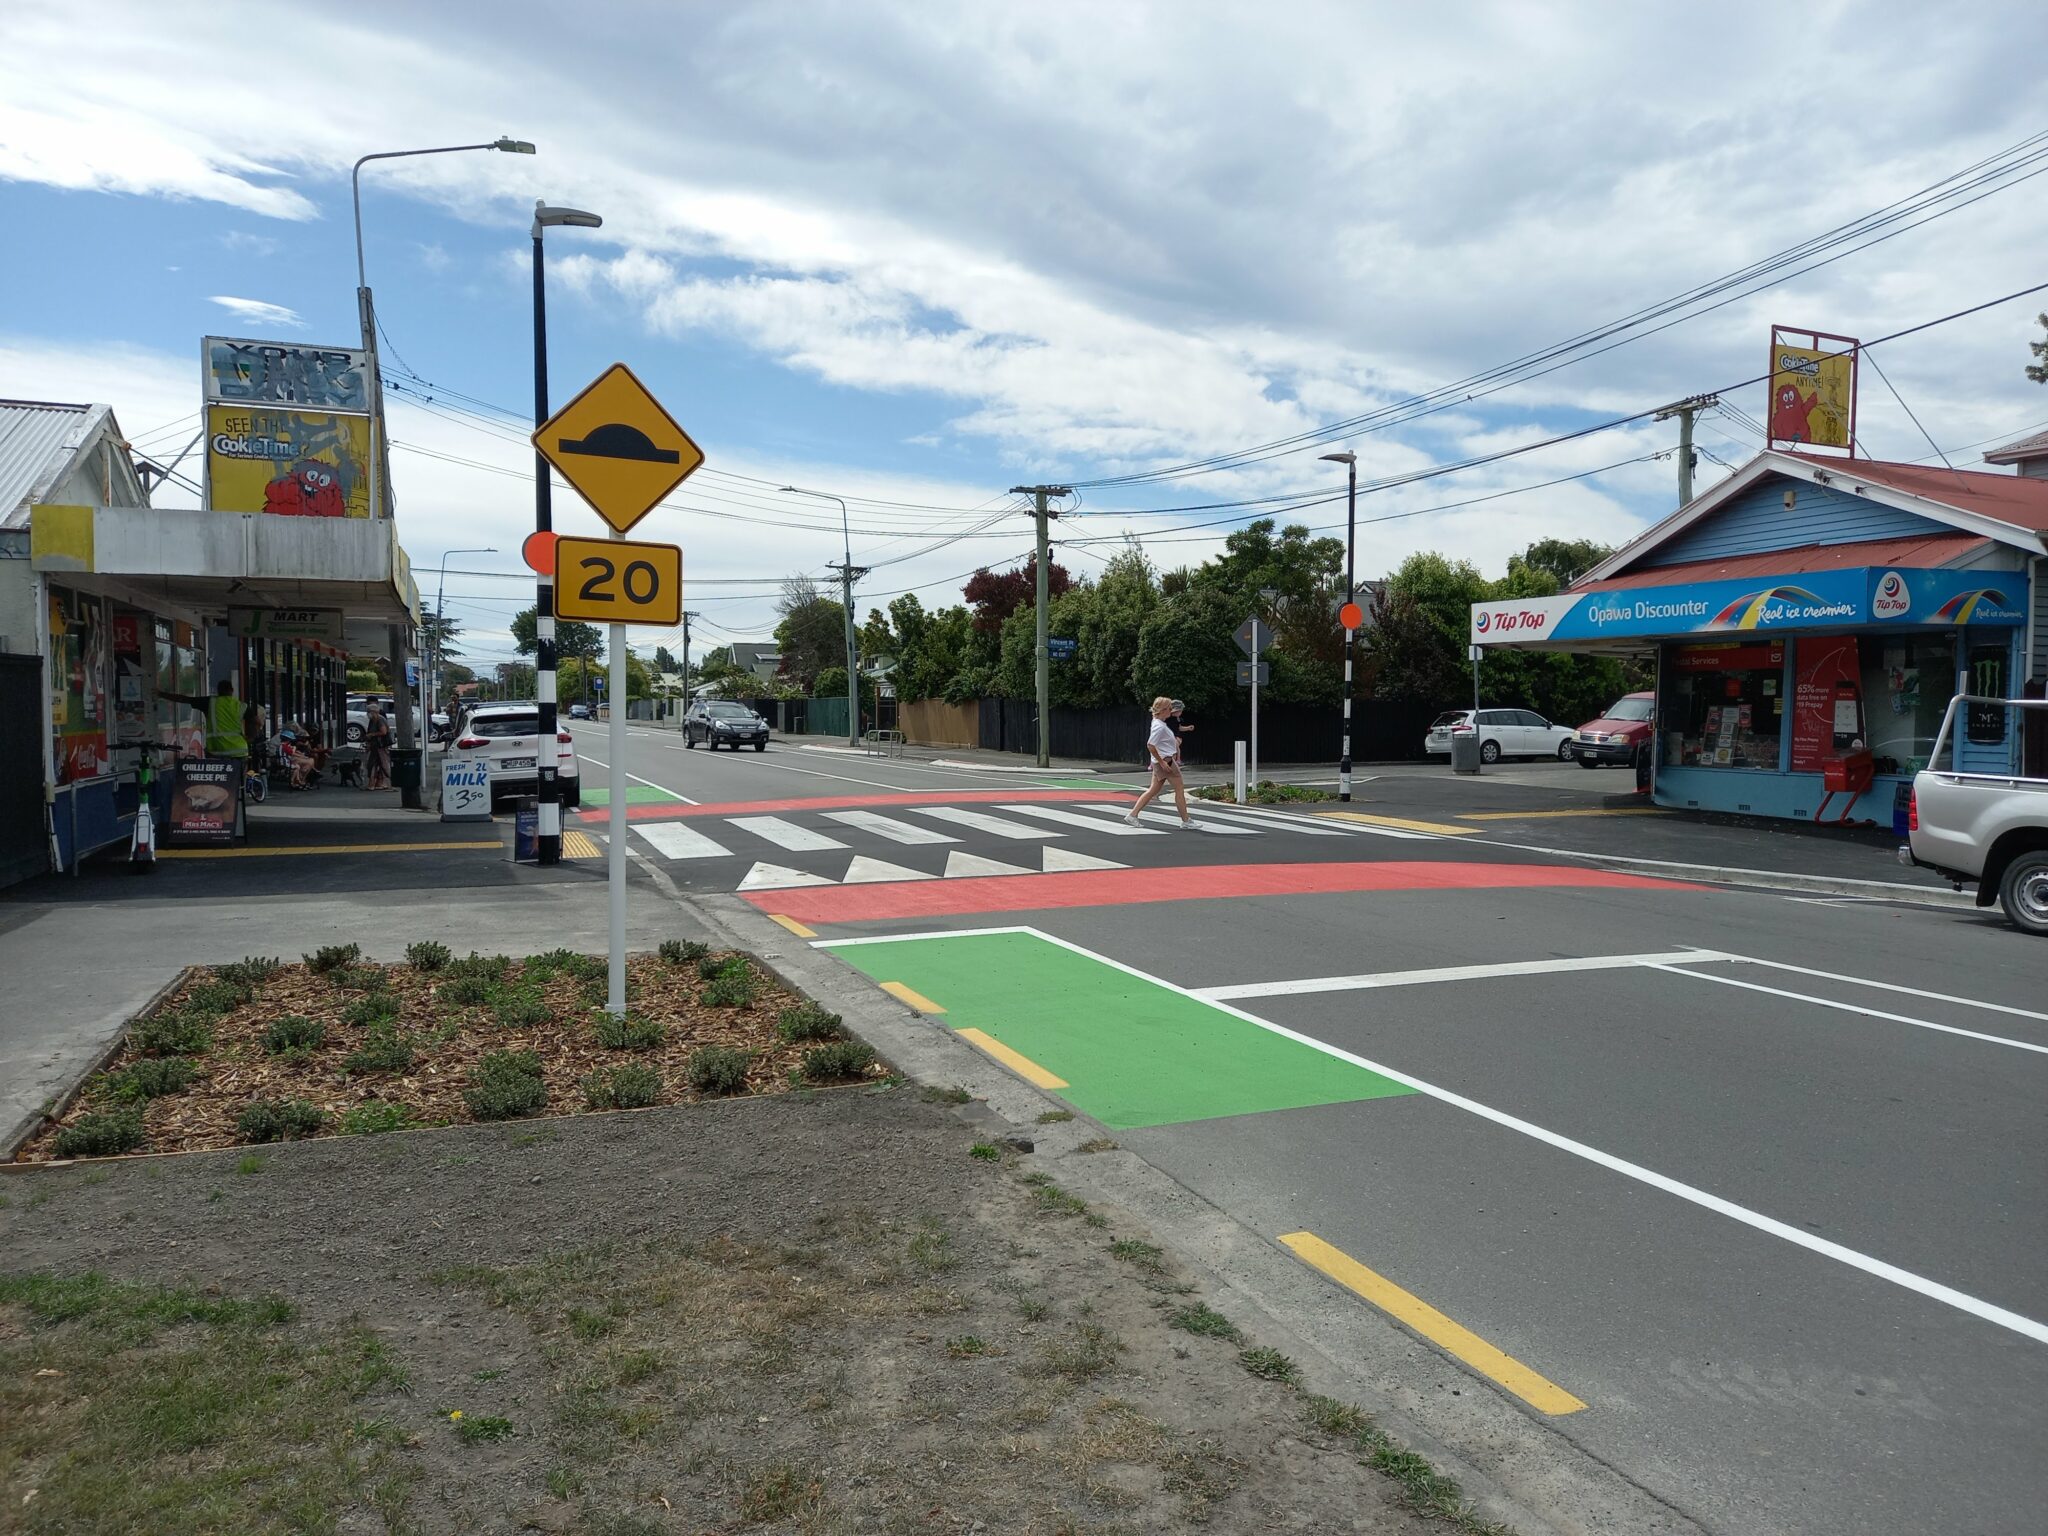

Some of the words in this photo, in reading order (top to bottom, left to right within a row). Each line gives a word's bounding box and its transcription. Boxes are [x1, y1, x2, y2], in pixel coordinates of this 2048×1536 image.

[225, 417, 258, 433] SEEN
[578, 556, 660, 605] 20
[1876, 599, 1890, 610] Tip
[1890, 599, 1907, 611] Top
[1588, 605, 1632, 628] Opawa
[1634, 599, 1709, 619] Discounter
[1757, 602, 1783, 623] Real
[1785, 605, 1801, 618] ice
[1803, 601, 1854, 618] creamier
[1975, 607, 1990, 618] Real
[243, 607, 263, 634] J
[273, 611, 320, 622] MART
[1494, 612, 1517, 632] Tip
[1518, 610, 1545, 630] Top
[1691, 656, 1720, 665] Services
[1797, 683, 1815, 694] 65%
[1805, 701, 1823, 709] Prepay
[182, 763, 205, 772] CHILLI
[205, 764, 226, 772] BEEF
[446, 764, 466, 772] FRESH
[475, 762, 487, 771] 2L
[186, 773, 214, 781] CHEESE
[214, 774, 228, 782] PIE
[446, 773, 488, 786] MILK
